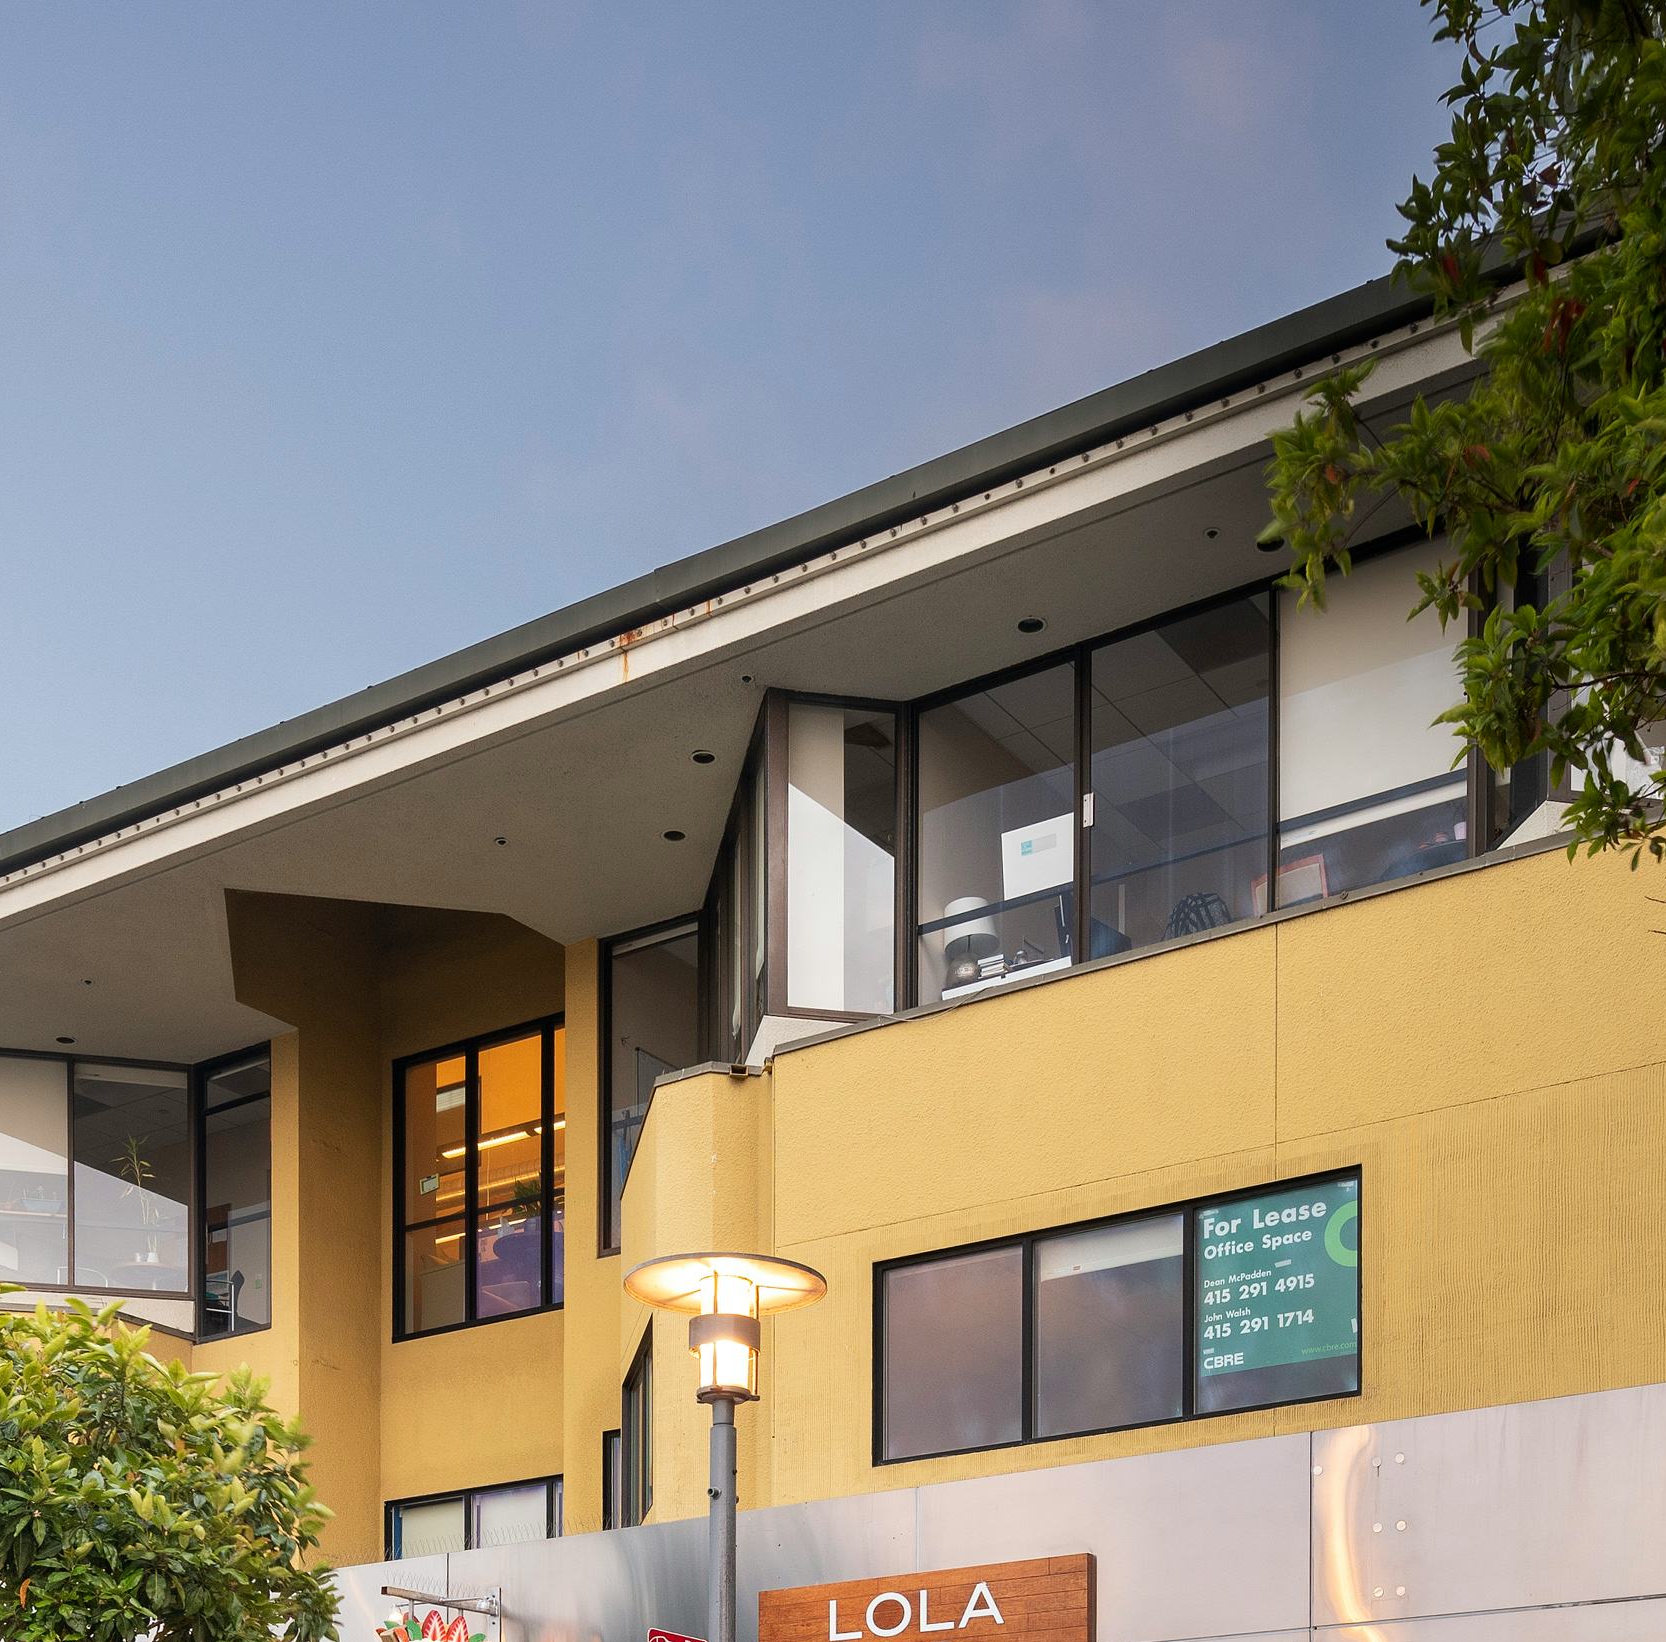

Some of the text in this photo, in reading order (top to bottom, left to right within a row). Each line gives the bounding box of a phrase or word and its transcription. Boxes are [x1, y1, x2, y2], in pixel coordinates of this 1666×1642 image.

[1204, 1202, 1327, 1239] For Lease
[1204, 1229, 1312, 1260] Office Space
[1204, 1268, 1272, 1289] Dean McPadden
[1204, 1274, 1315, 1306] 415 291 4915
[1204, 1307, 1251, 1323] John Walsh
[1204, 1309, 1314, 1340] 415 291 1714
[1203, 1352, 1244, 1370] CBRE
[829, 1581, 1004, 1641] LOLA
